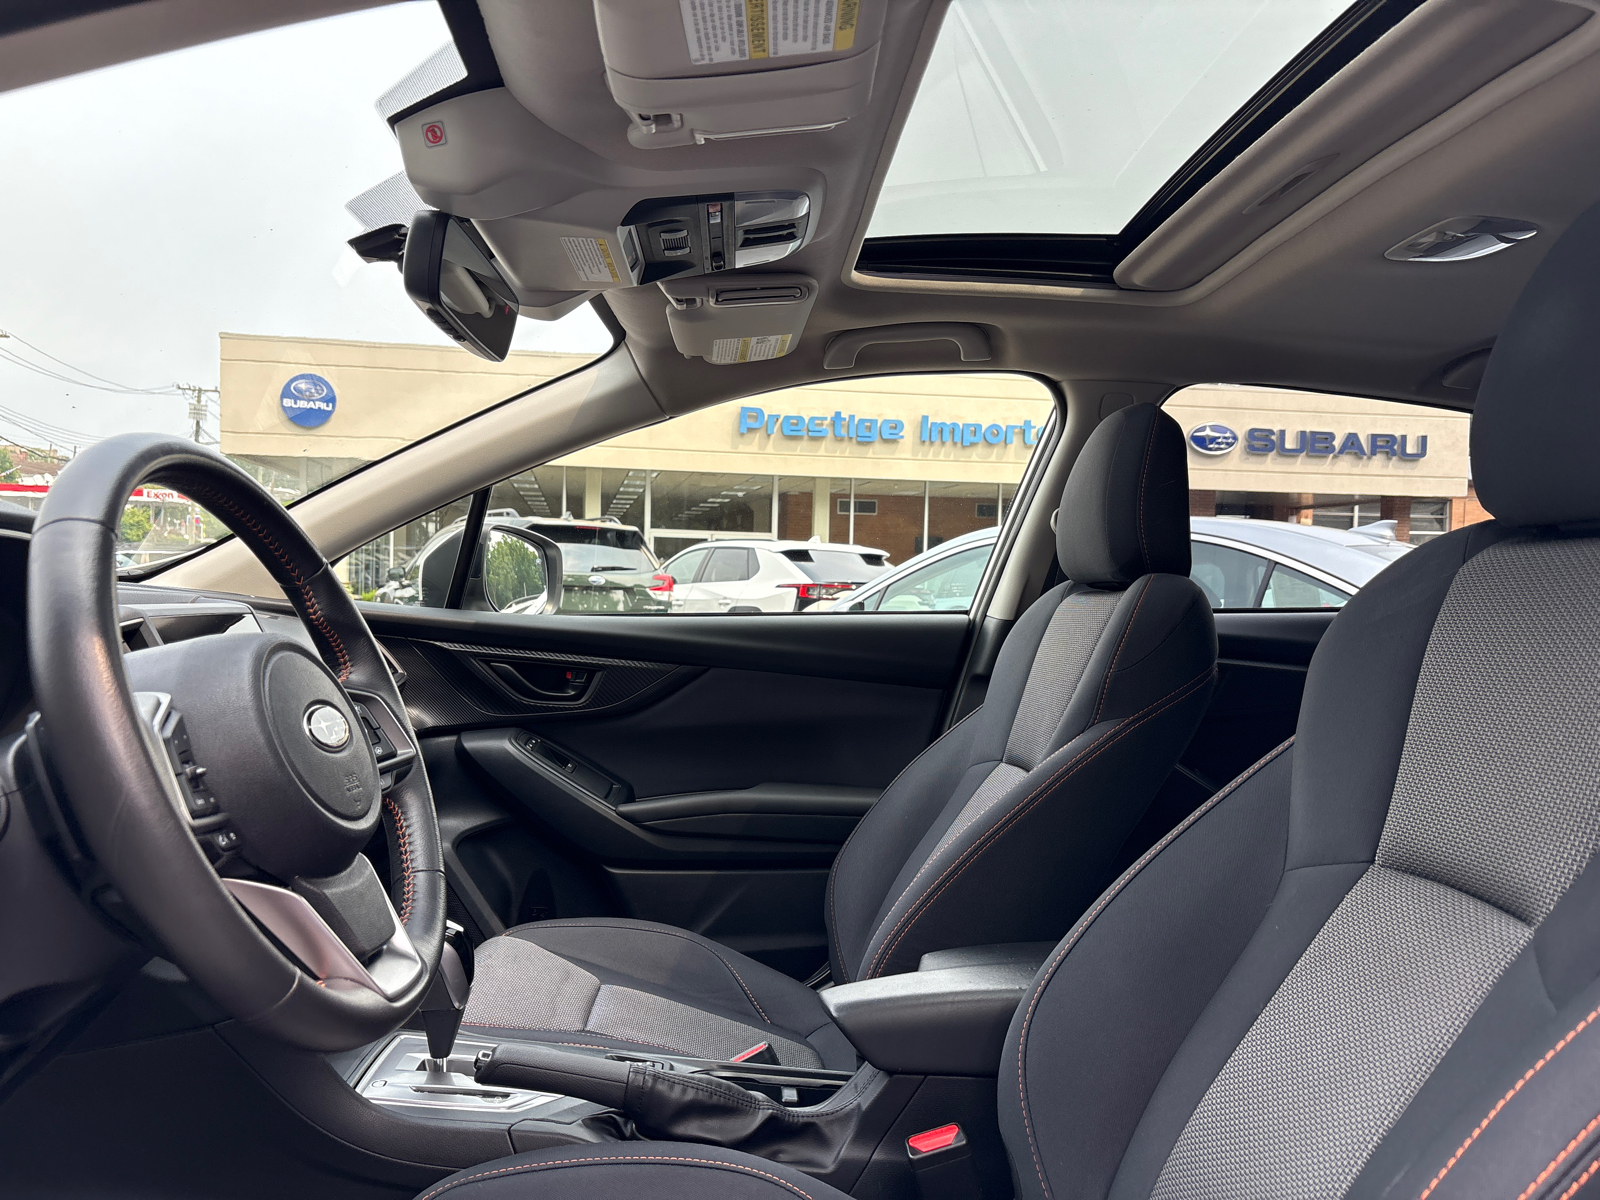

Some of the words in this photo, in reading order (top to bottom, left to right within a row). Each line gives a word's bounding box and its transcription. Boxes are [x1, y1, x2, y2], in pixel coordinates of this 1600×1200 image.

[839, 0, 857, 31] RNING
[283, 398, 333, 411] SUBARU
[739, 406, 905, 443] Prestige
[1246, 428, 1429, 460] SUBARU
[146, 491, 174, 501] Exxon
